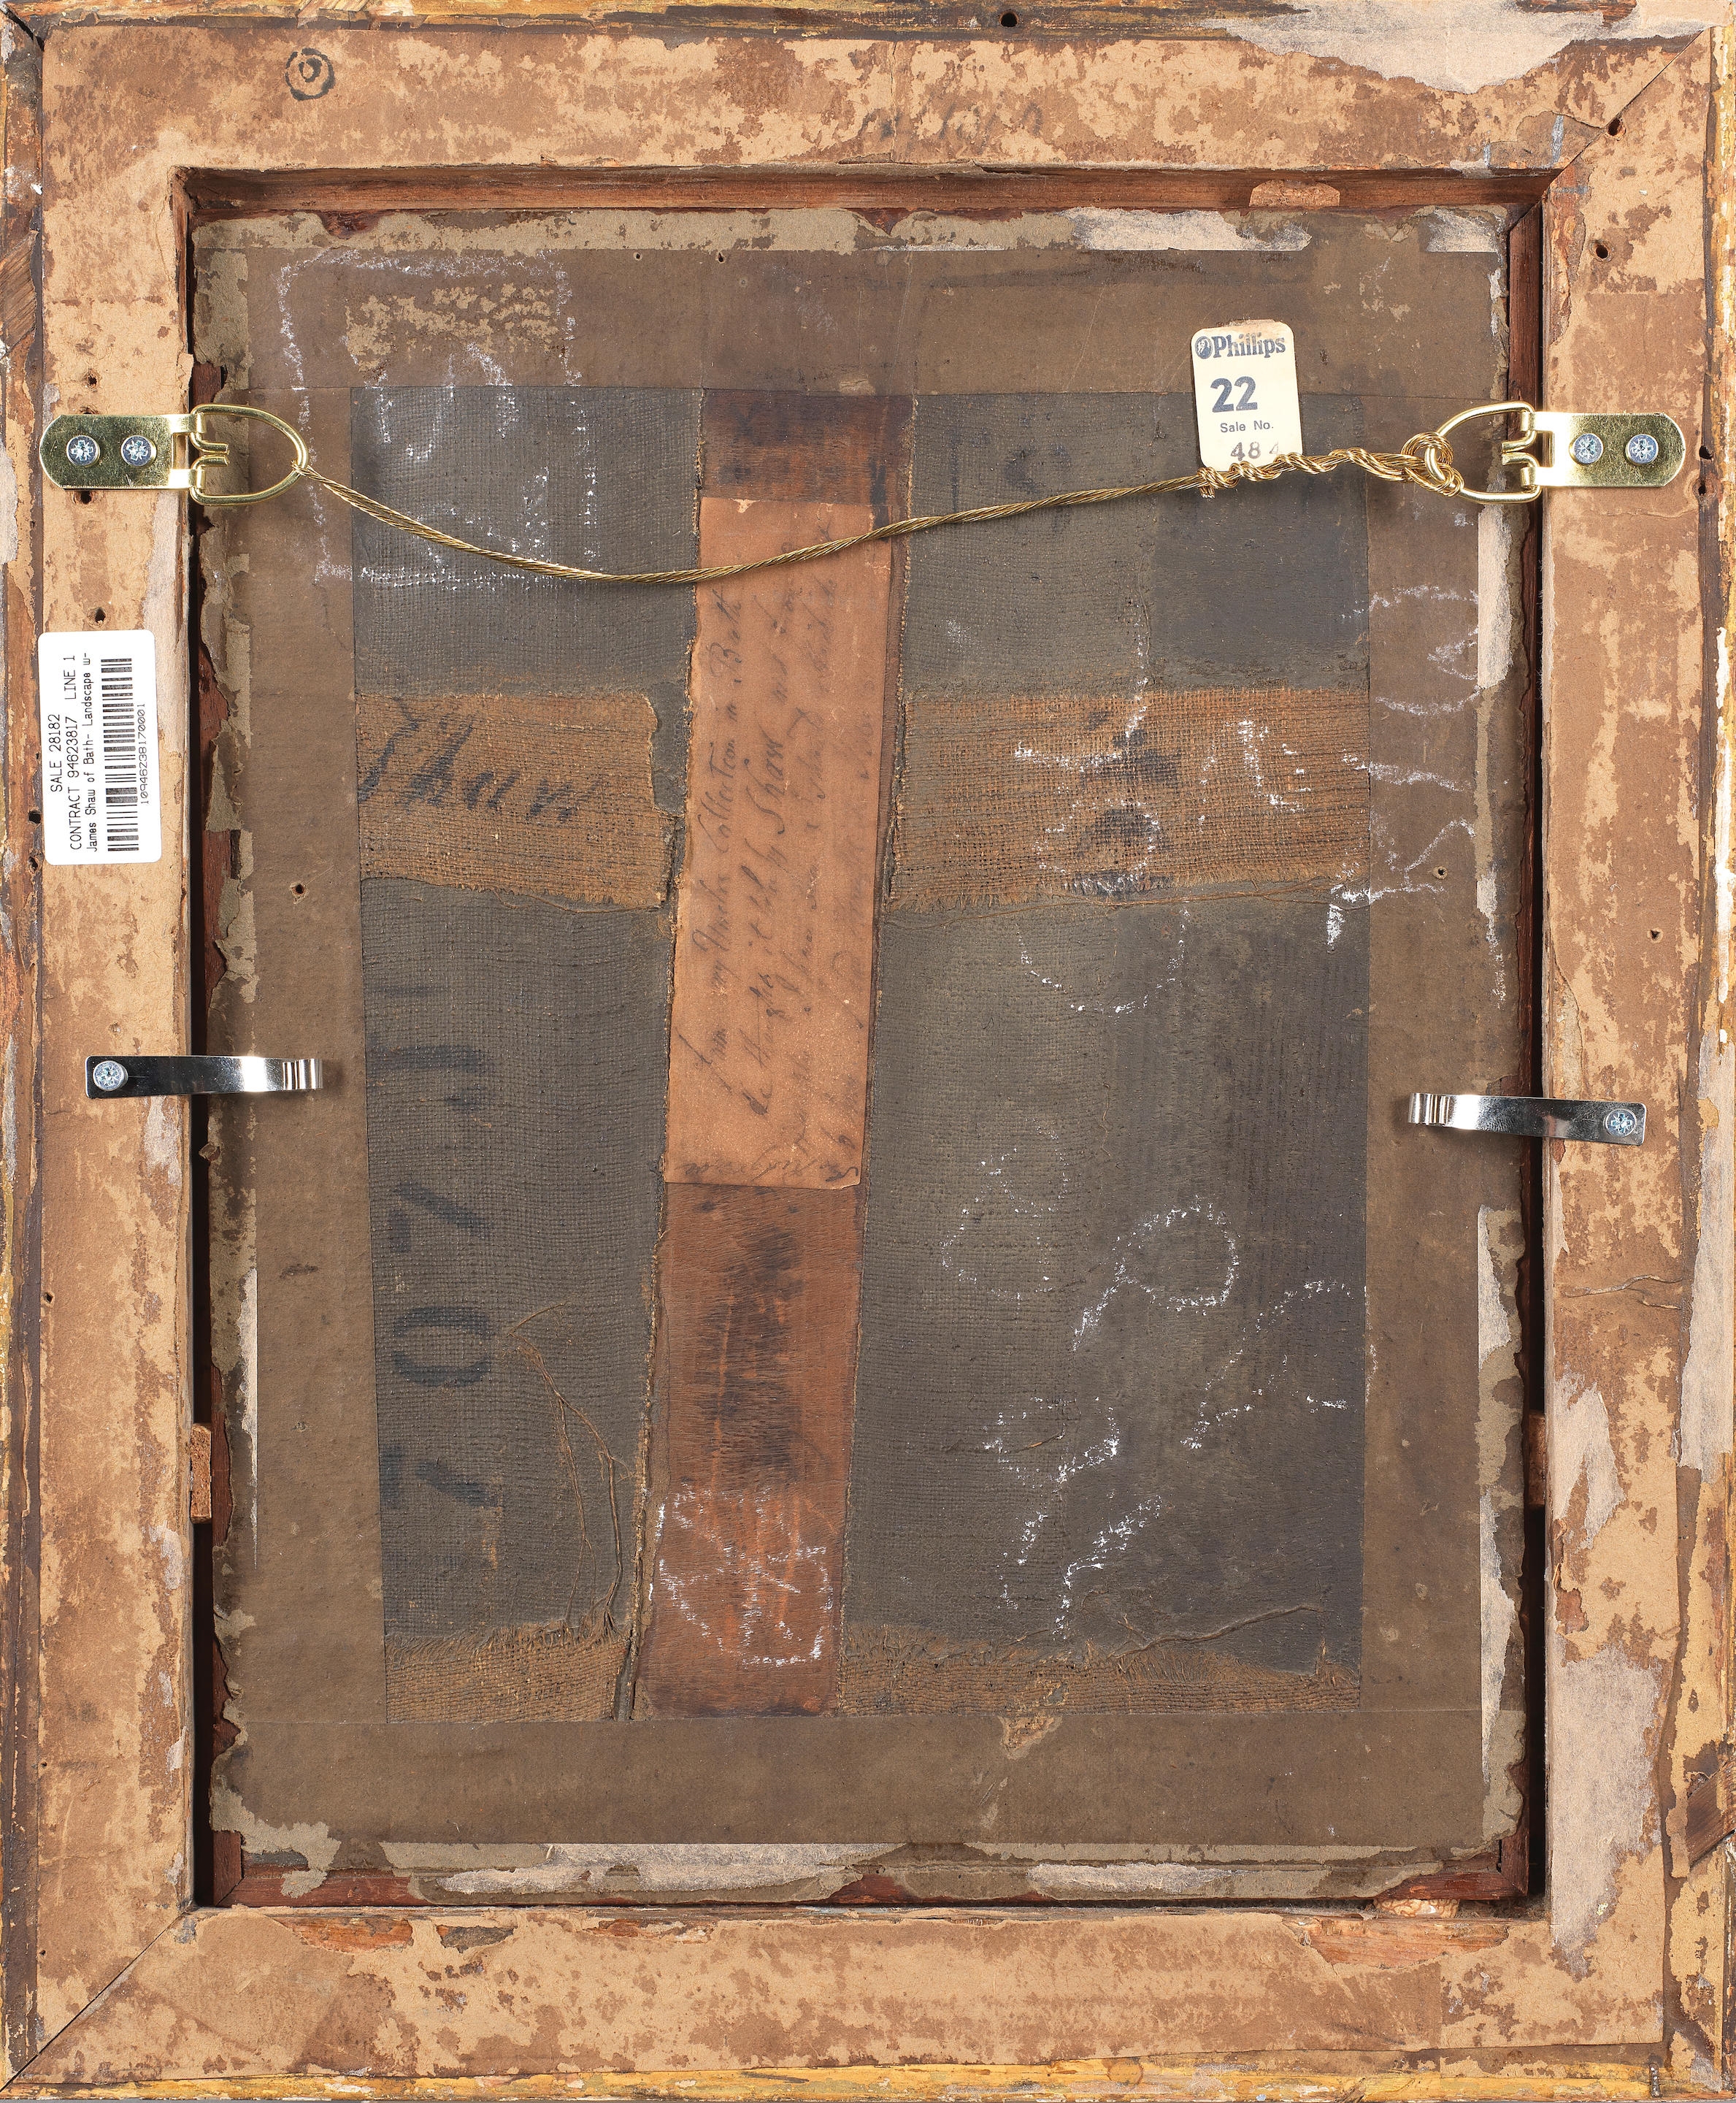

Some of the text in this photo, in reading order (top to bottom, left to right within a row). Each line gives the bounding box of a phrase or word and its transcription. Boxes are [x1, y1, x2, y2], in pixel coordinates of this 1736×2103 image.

[1212, 332, 1286, 358] Phillips
[1210, 376, 1258, 413] 22
[1220, 420, 1274, 432] Sale No.
[64, 670, 76, 699] LINE
[48, 715, 62, 792] SALE 28182
[65, 716, 79, 778] 94623817
[81, 653, 98, 851] James Shaw of Bath- Landscape w-
[137, 704, 148, 805] 10946238170001
[744, 709, 786, 834] Shaw
[68, 787, 82, 849] CONTRACT
